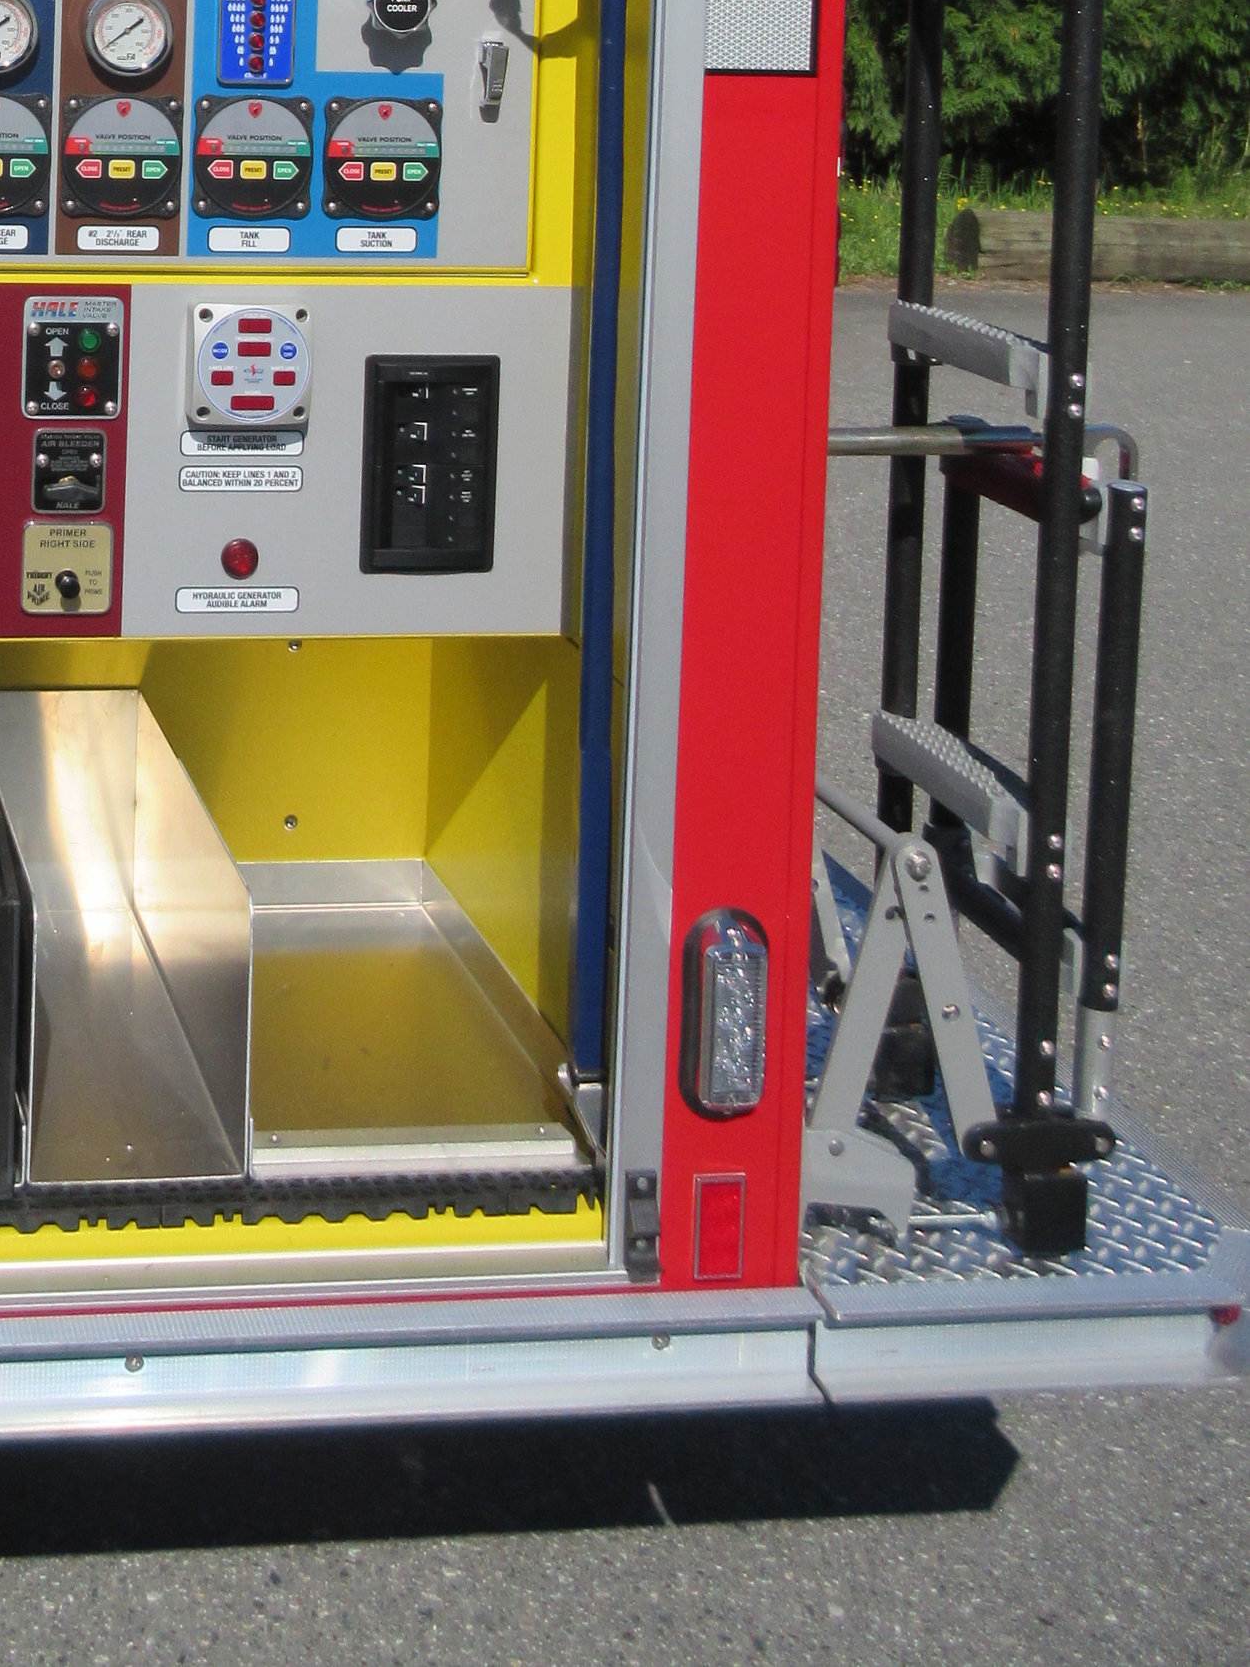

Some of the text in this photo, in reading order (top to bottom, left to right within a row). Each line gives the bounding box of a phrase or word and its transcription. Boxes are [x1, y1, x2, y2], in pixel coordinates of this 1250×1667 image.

[387, 4, 417, 13] COOLER
[126, 230, 147, 238] REAR
[240, 231, 260, 239] TANK
[367, 231, 387, 239] TANK
[95, 238, 140, 247] DISCHARGE
[241, 240, 257, 248] FILL
[360, 240, 392, 248] SUCTION
[31, 301, 78, 317] HALE
[45, 327, 69, 335] OPEN
[40, 402, 69, 410] CLOSE
[207, 435, 277, 443] START GENERATOR
[197, 443, 286, 451] BEFORE APPLYING LOAD
[185, 470, 220, 479] CAUTION:
[265, 479, 299, 487] PERCENT
[49, 529, 86, 537] PRIMER
[40, 540, 95, 548] RIGHT SIDE
[237, 592, 282, 600] GENERATOR
[206, 600, 239, 608] AUDIBLE
